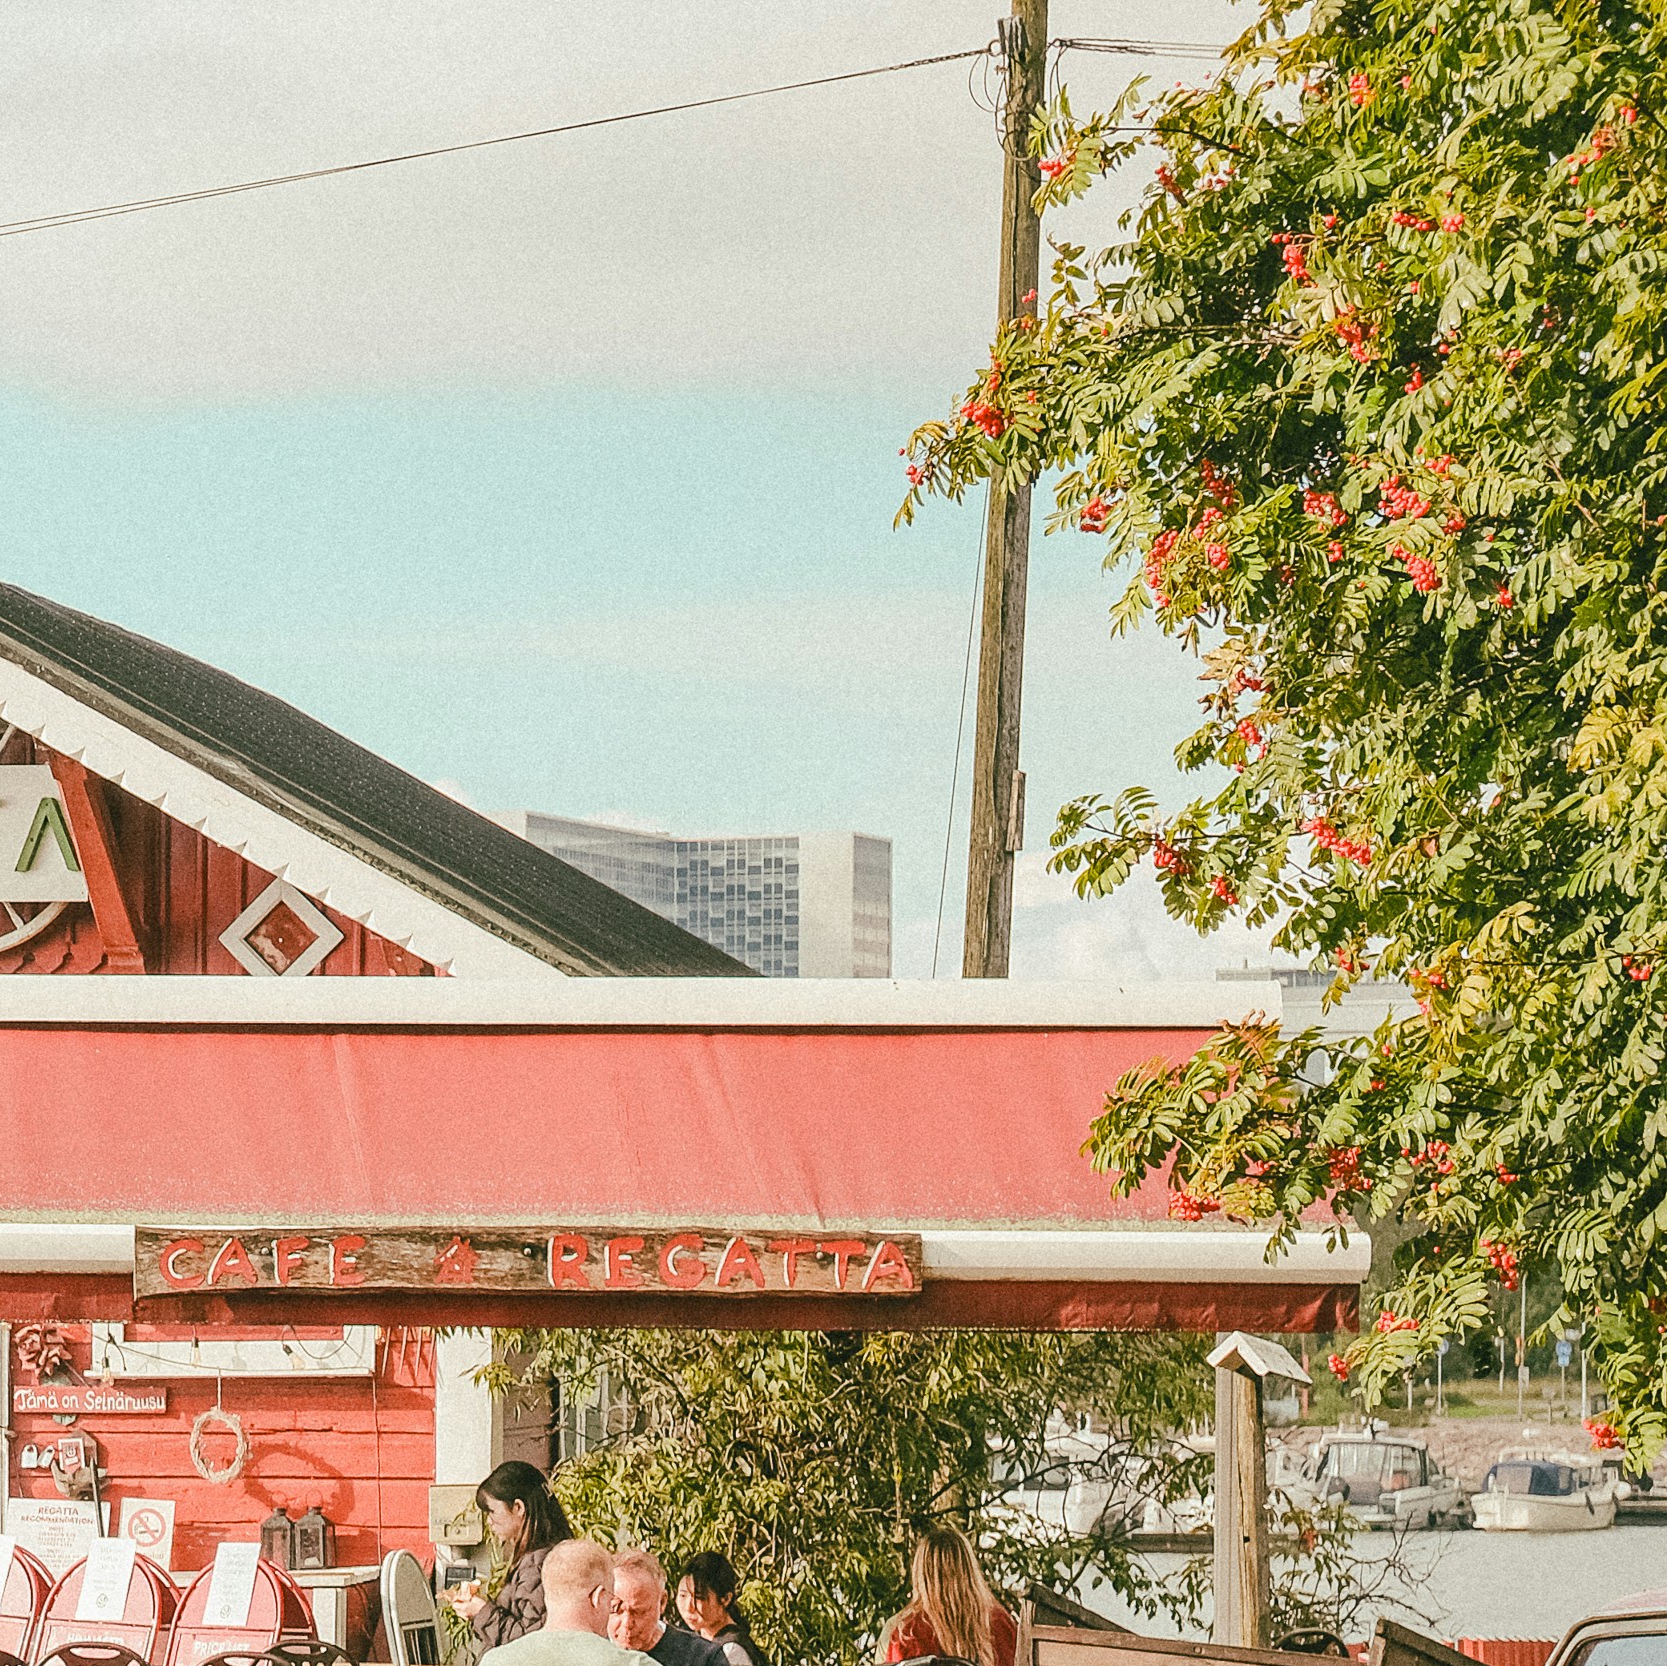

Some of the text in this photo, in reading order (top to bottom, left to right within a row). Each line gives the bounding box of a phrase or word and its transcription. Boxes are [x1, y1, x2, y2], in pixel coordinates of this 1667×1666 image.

[158, 1232, 916, 1292] CAFE REGATTA
[13, 1388, 59, 1411] Tämä
[62, 1395, 80, 1409] on
[37, 1505, 80, 1517] REGATTA
